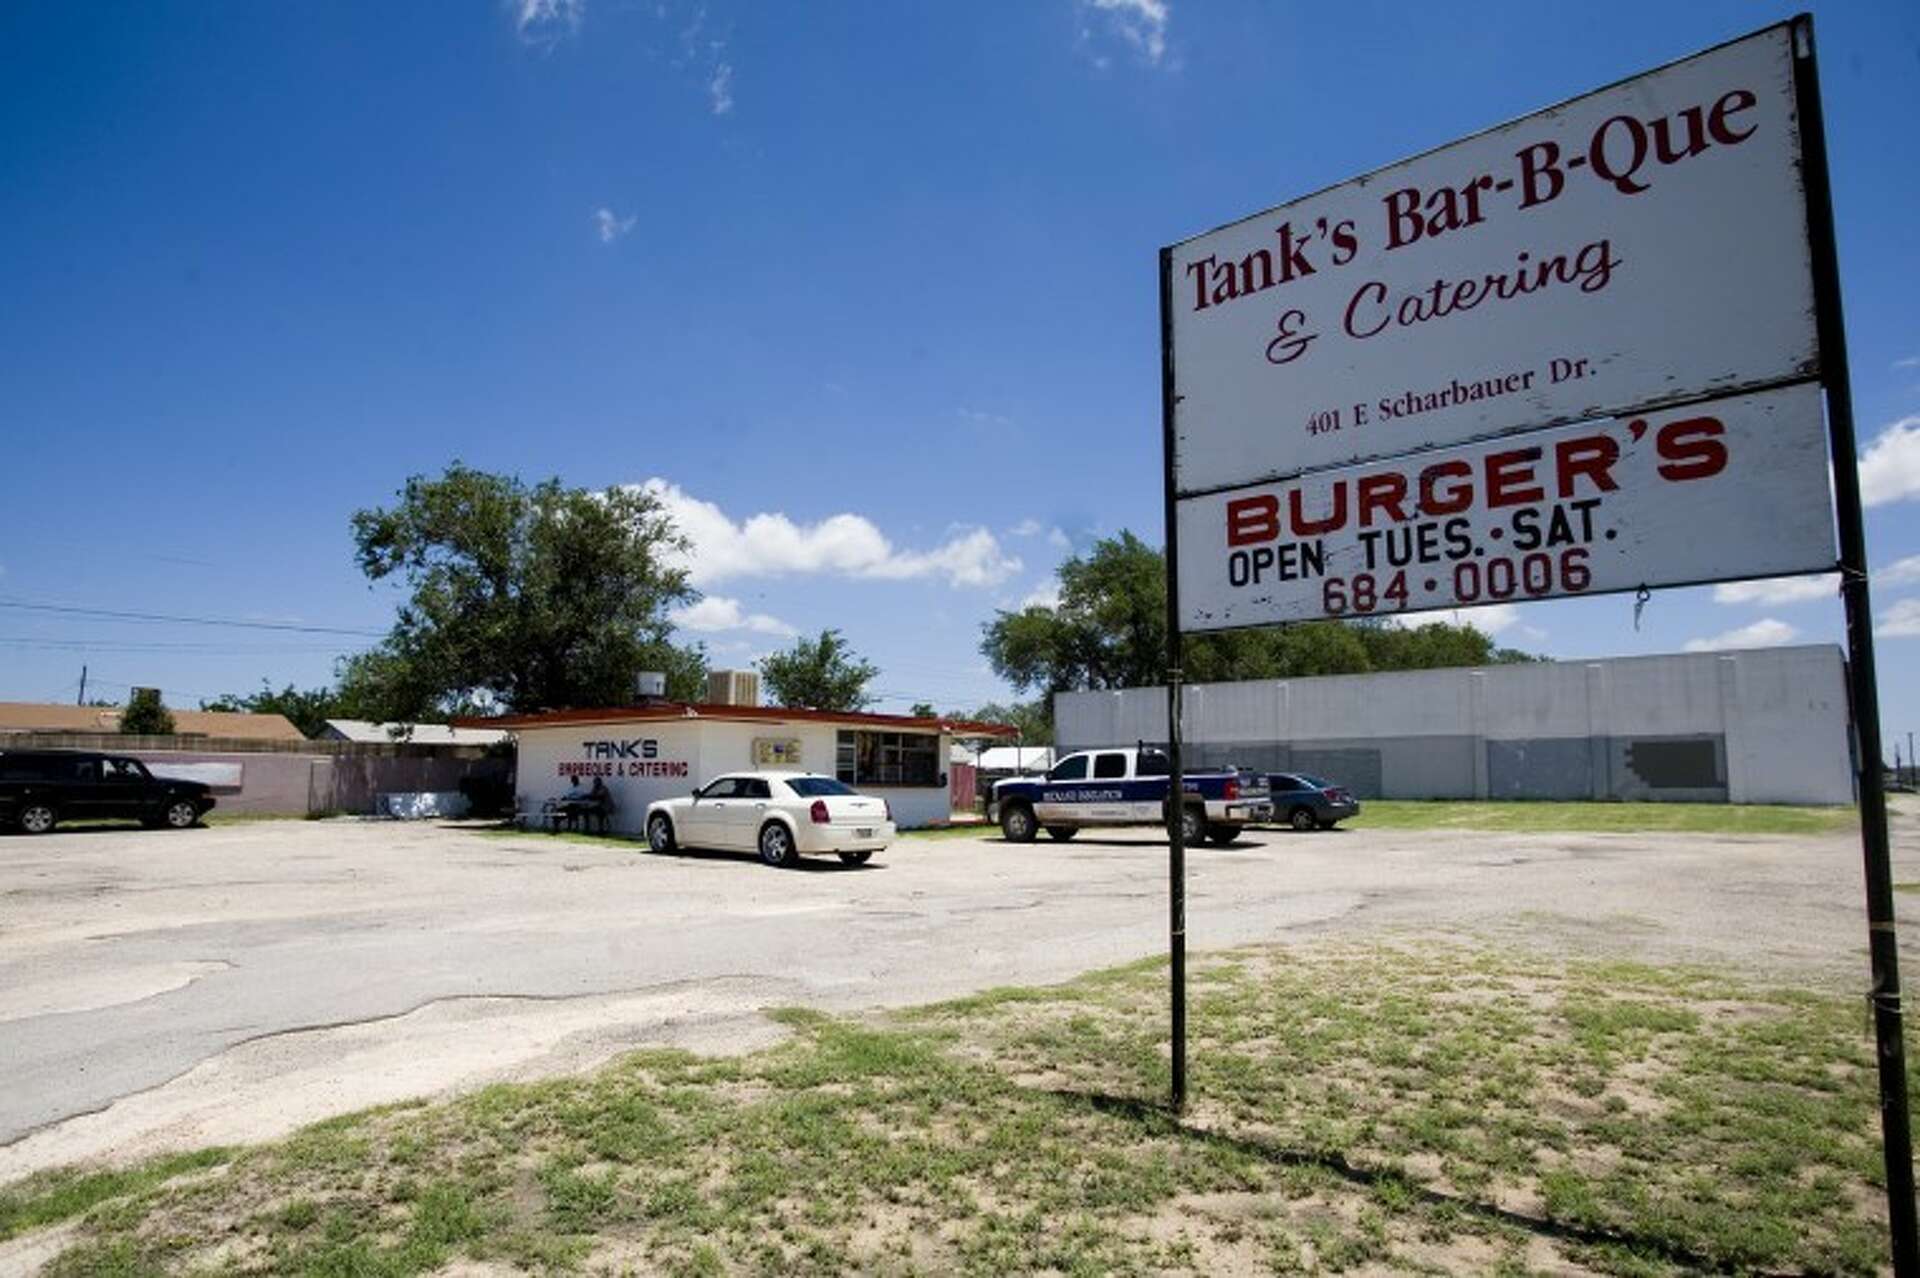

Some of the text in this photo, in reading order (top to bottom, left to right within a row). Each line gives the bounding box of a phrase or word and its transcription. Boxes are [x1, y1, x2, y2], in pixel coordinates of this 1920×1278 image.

[1186, 88, 1759, 312] Tank's Bar-B-Que
[1265, 239, 1622, 364] & Catering
[1305, 357, 1597, 438] 401 E Scharbauer Dr.
[1225, 416, 1729, 548] BURGER'S
[1229, 541, 1325, 587] OPEN
[629, 761, 688, 777] CATERING
